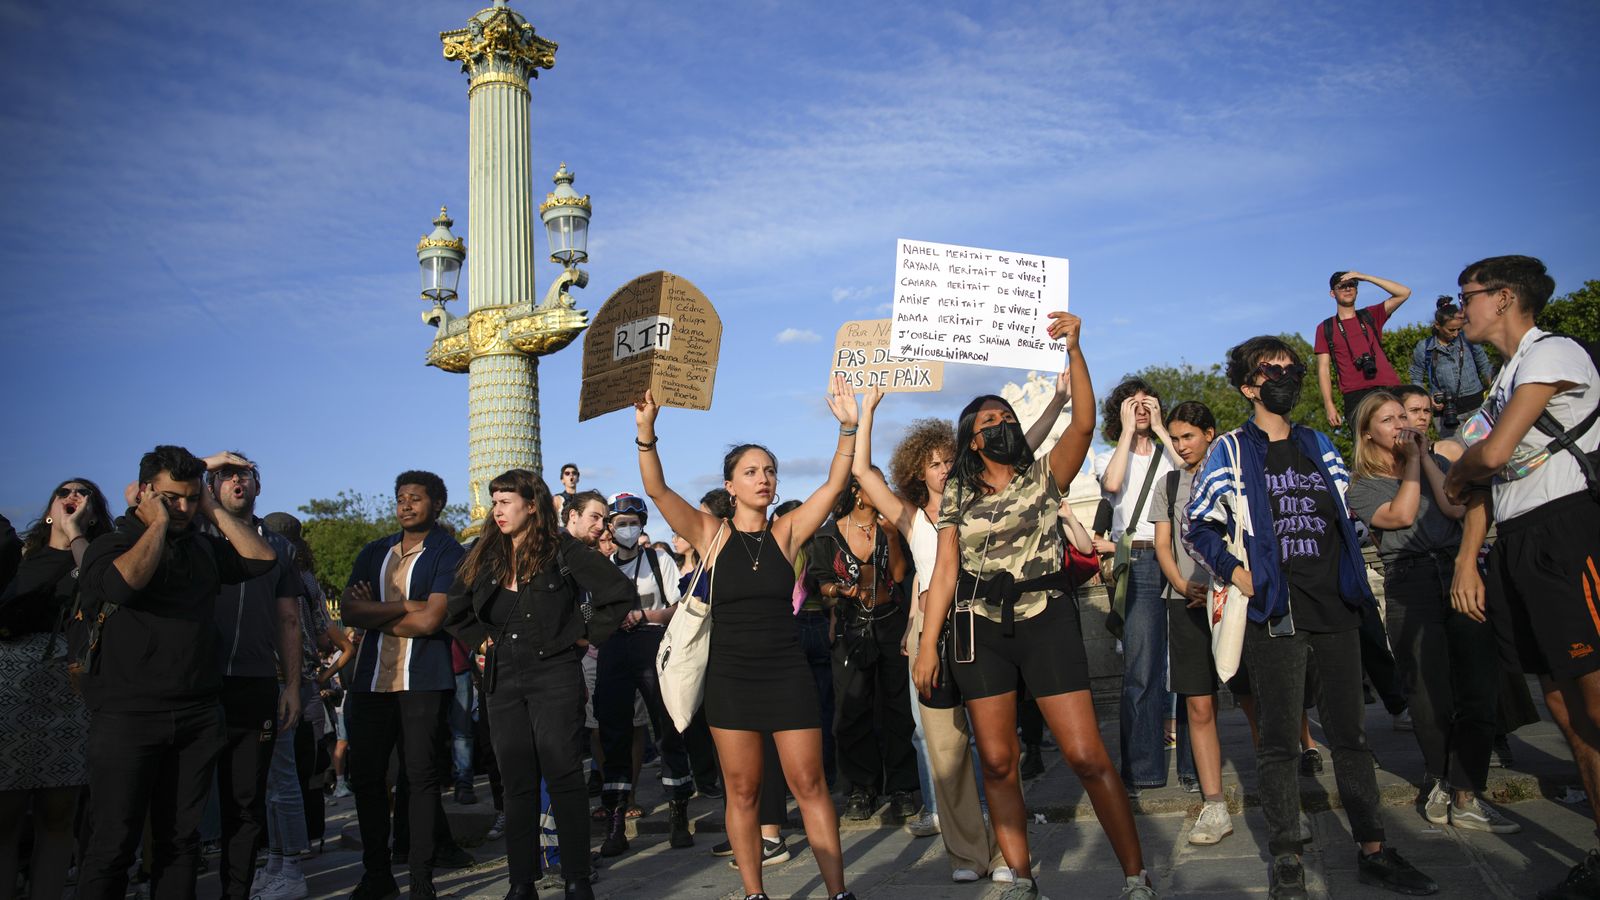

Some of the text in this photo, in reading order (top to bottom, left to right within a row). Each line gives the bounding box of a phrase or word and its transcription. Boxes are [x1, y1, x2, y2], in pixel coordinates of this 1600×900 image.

[903, 243, 940, 256] NAHEL
[946, 250, 992, 260] MERITAIT
[999, 256, 1010, 265] DE
[903, 259, 940, 272] RAYANA
[949, 264, 997, 277] MERITAIT
[1002, 271, 1014, 279] DE
[901, 278, 937, 287] CAMARA
[947, 278, 991, 290] MERITAIT
[998, 287, 1009, 295] DE
[676, 303, 705, 314] Cédric
[900, 294, 930, 305] AMINE
[938, 297, 985, 308] MERITAIT
[994, 305, 1006, 313] DE
[898, 313, 928, 322] ADAMA
[938, 314, 983, 326] MERITAIT
[992, 321, 1003, 329] DE
[672, 324, 705, 338] Adama
[899, 330, 947, 341] J'OUBLIE
[953, 334, 971, 343] PAS
[1049, 342, 1065, 352] VIVE
[837, 349, 866, 367] PAS
[868, 371, 889, 386] DE
[894, 366, 931, 386] PAIX
[1279, 494, 1317, 515] are
[1280, 535, 1321, 564] fun
